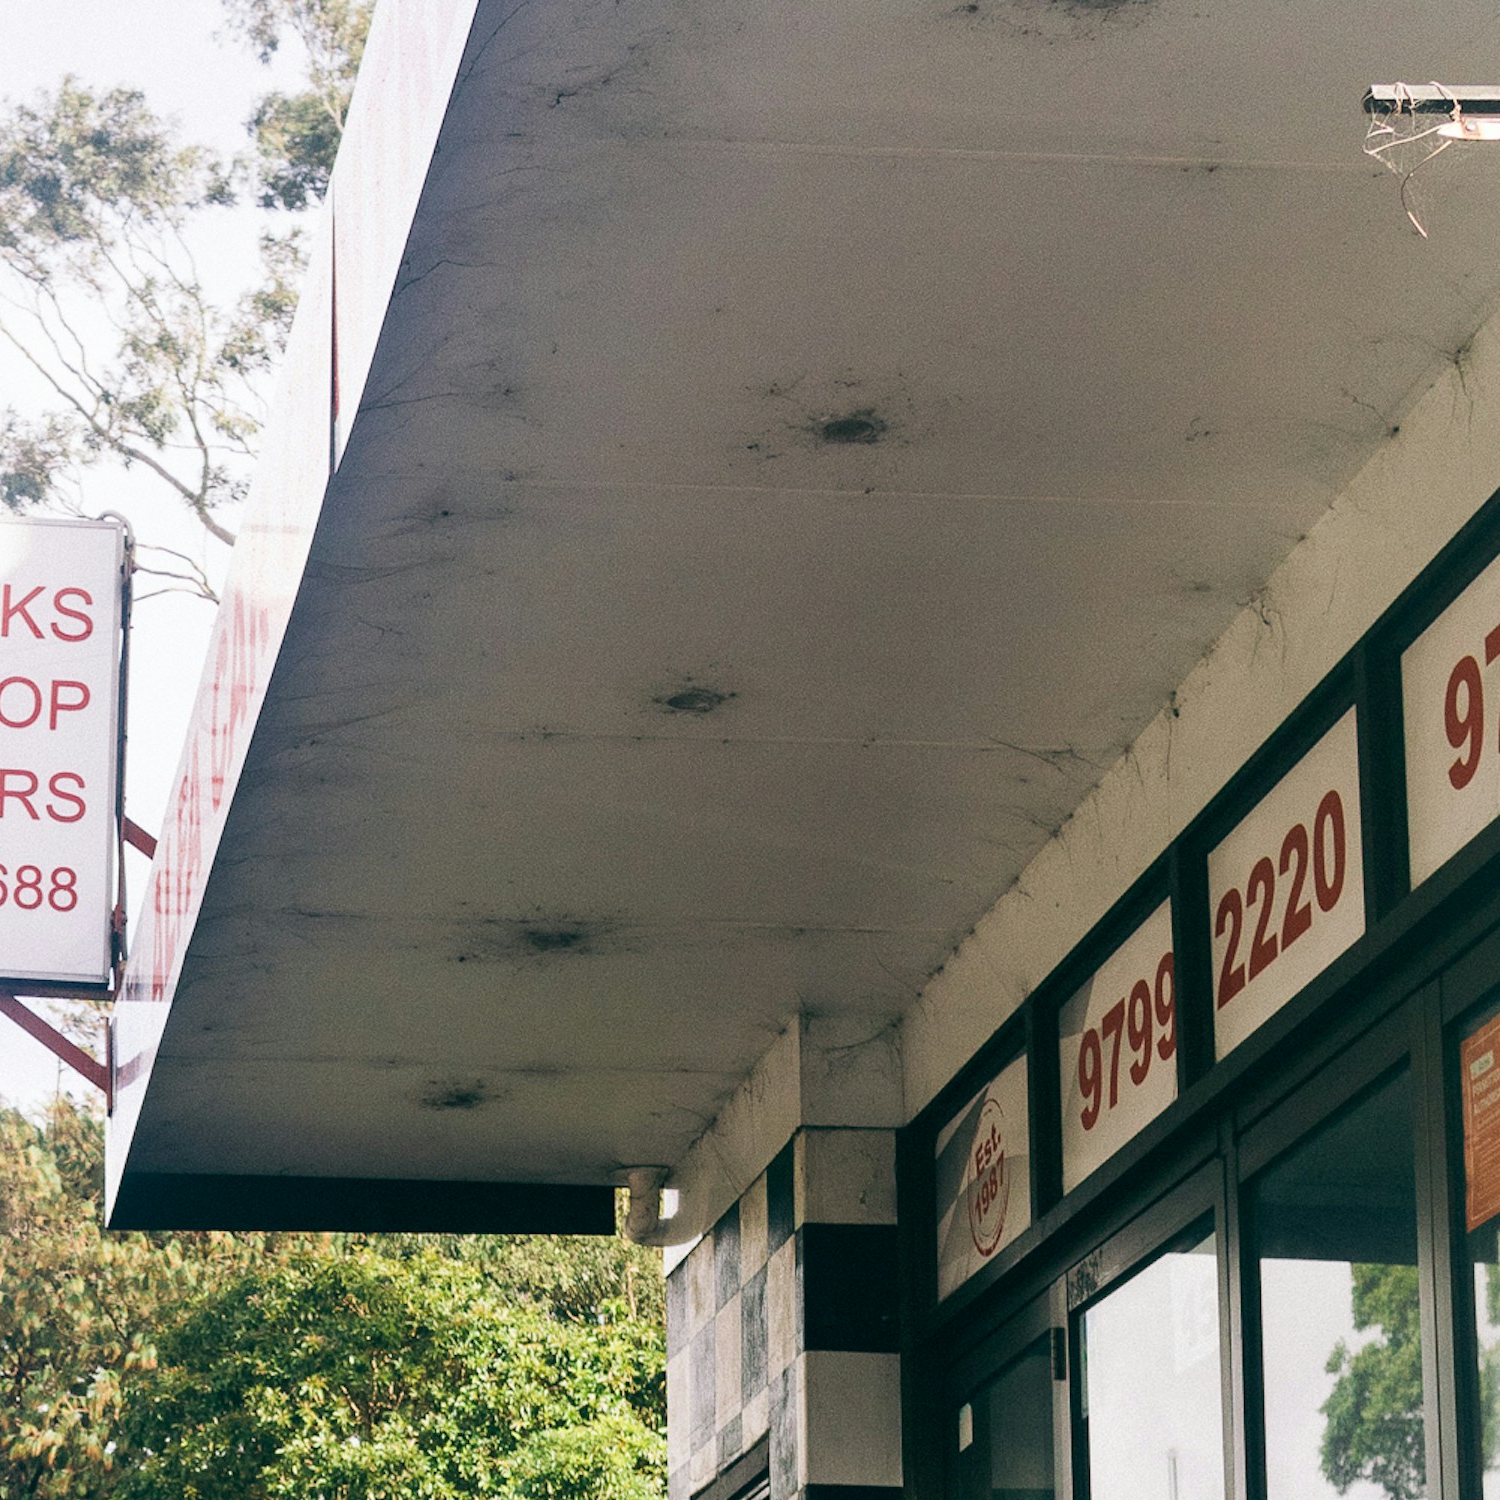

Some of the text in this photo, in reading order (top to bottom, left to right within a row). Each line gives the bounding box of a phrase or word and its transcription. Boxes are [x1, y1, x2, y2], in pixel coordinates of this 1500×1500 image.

[1078, 790, 1346, 1131] 9799 2220
[975, 1122, 1001, 1180] Est.
